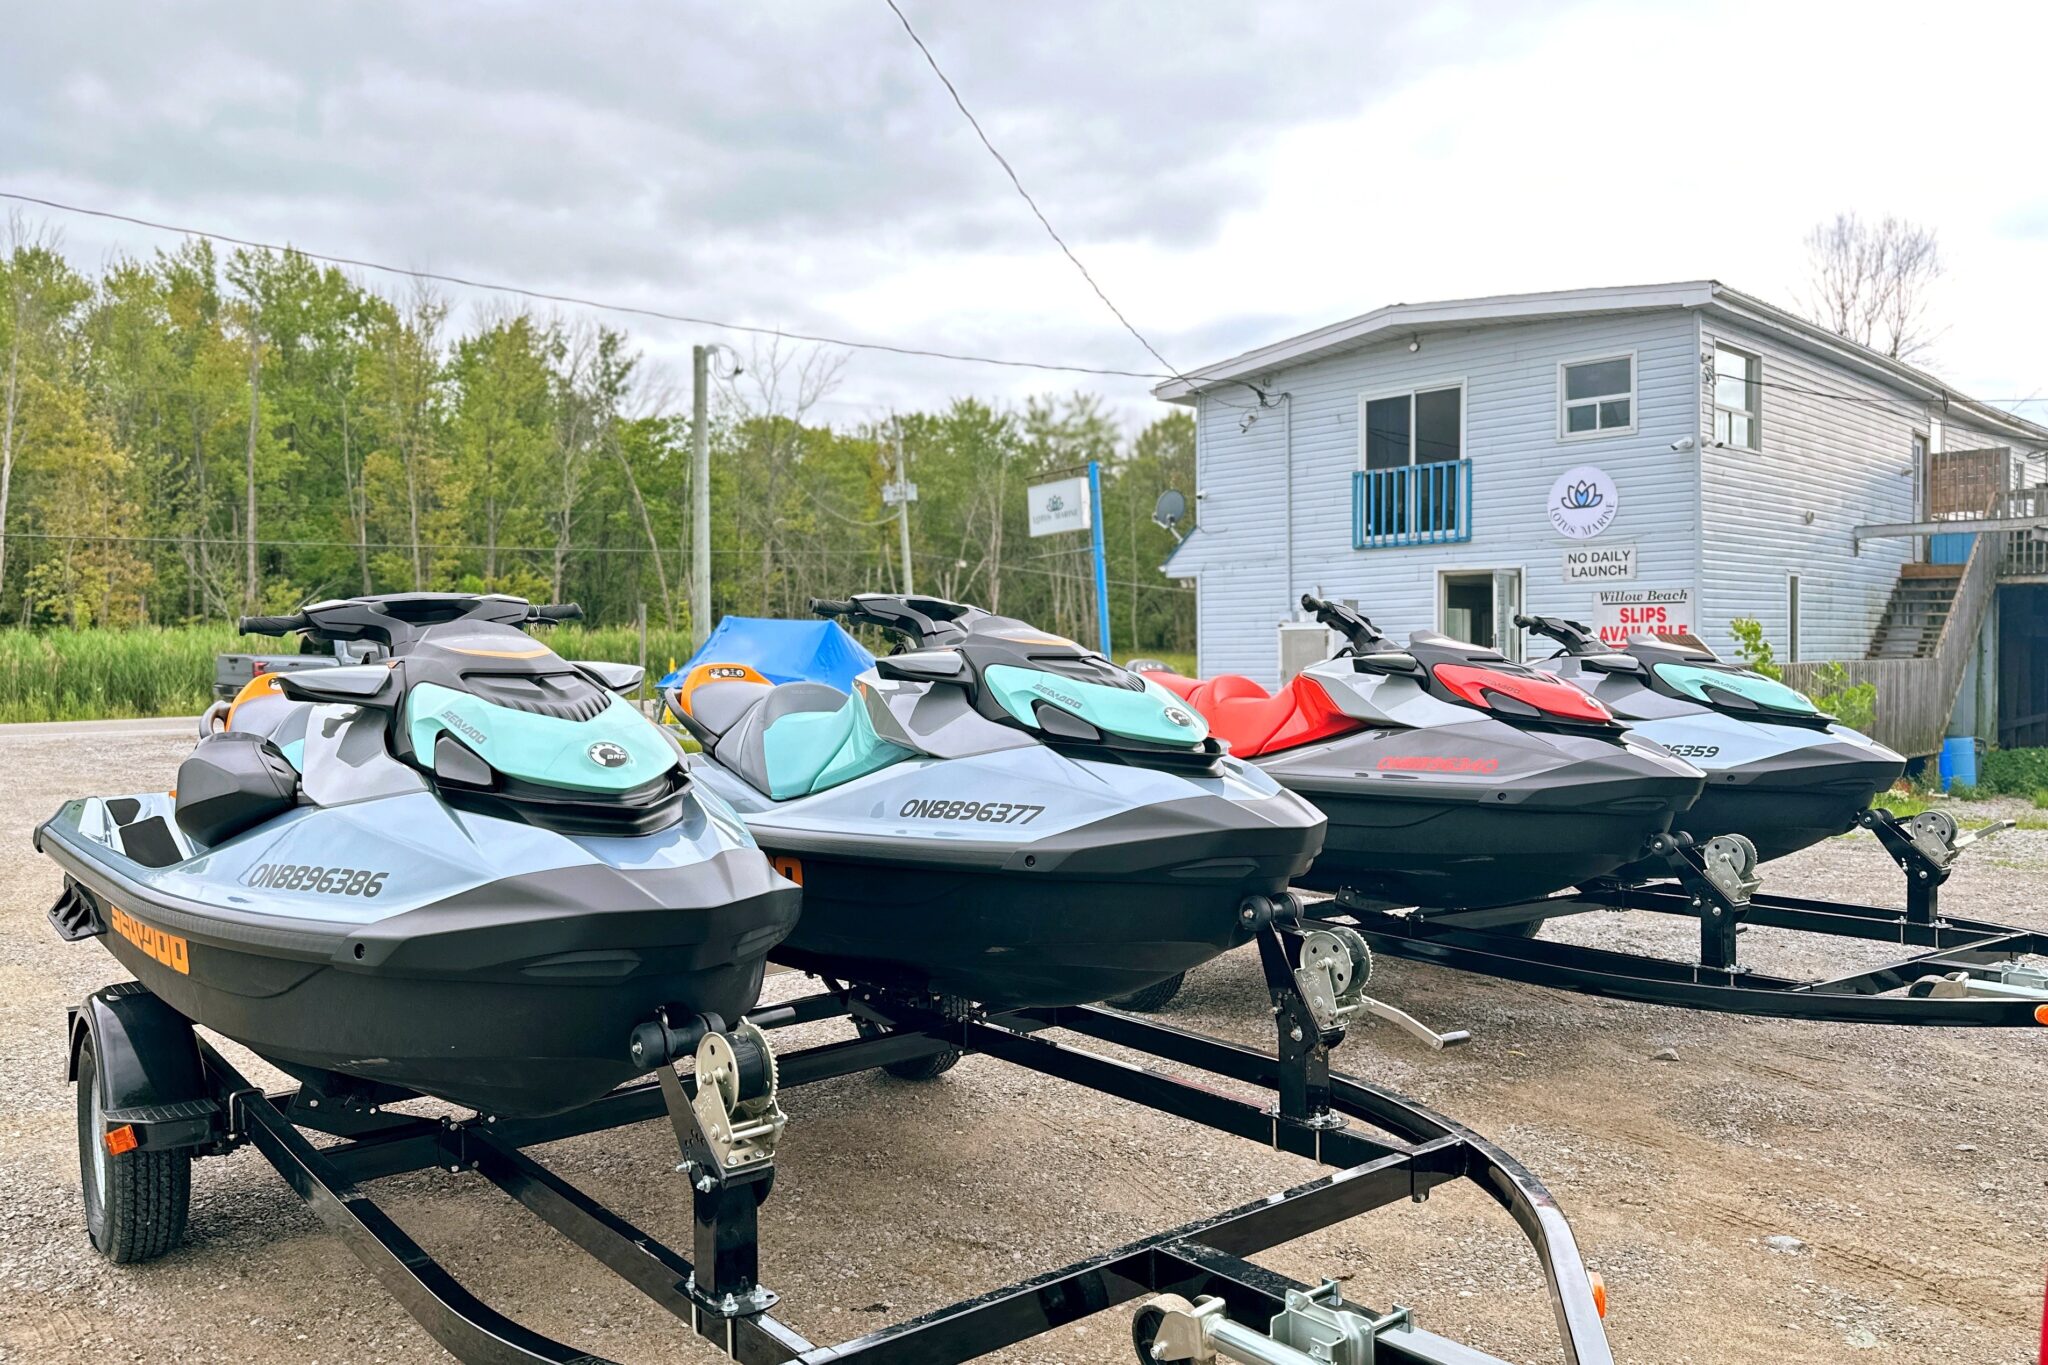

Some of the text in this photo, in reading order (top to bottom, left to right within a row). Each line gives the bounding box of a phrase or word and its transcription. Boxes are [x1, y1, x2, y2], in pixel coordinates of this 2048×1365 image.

[1550, 501, 1616, 536] LOTUS MARINE
[1567, 549, 1631, 564] NO DAILY
[1571, 564, 1628, 578] LAUNCH
[1599, 589, 1688, 602] Willow Beach
[1619, 606, 1667, 624] SLIPS
[899, 798, 1046, 825] ON8896377
[247, 863, 390, 898] ON8896386
